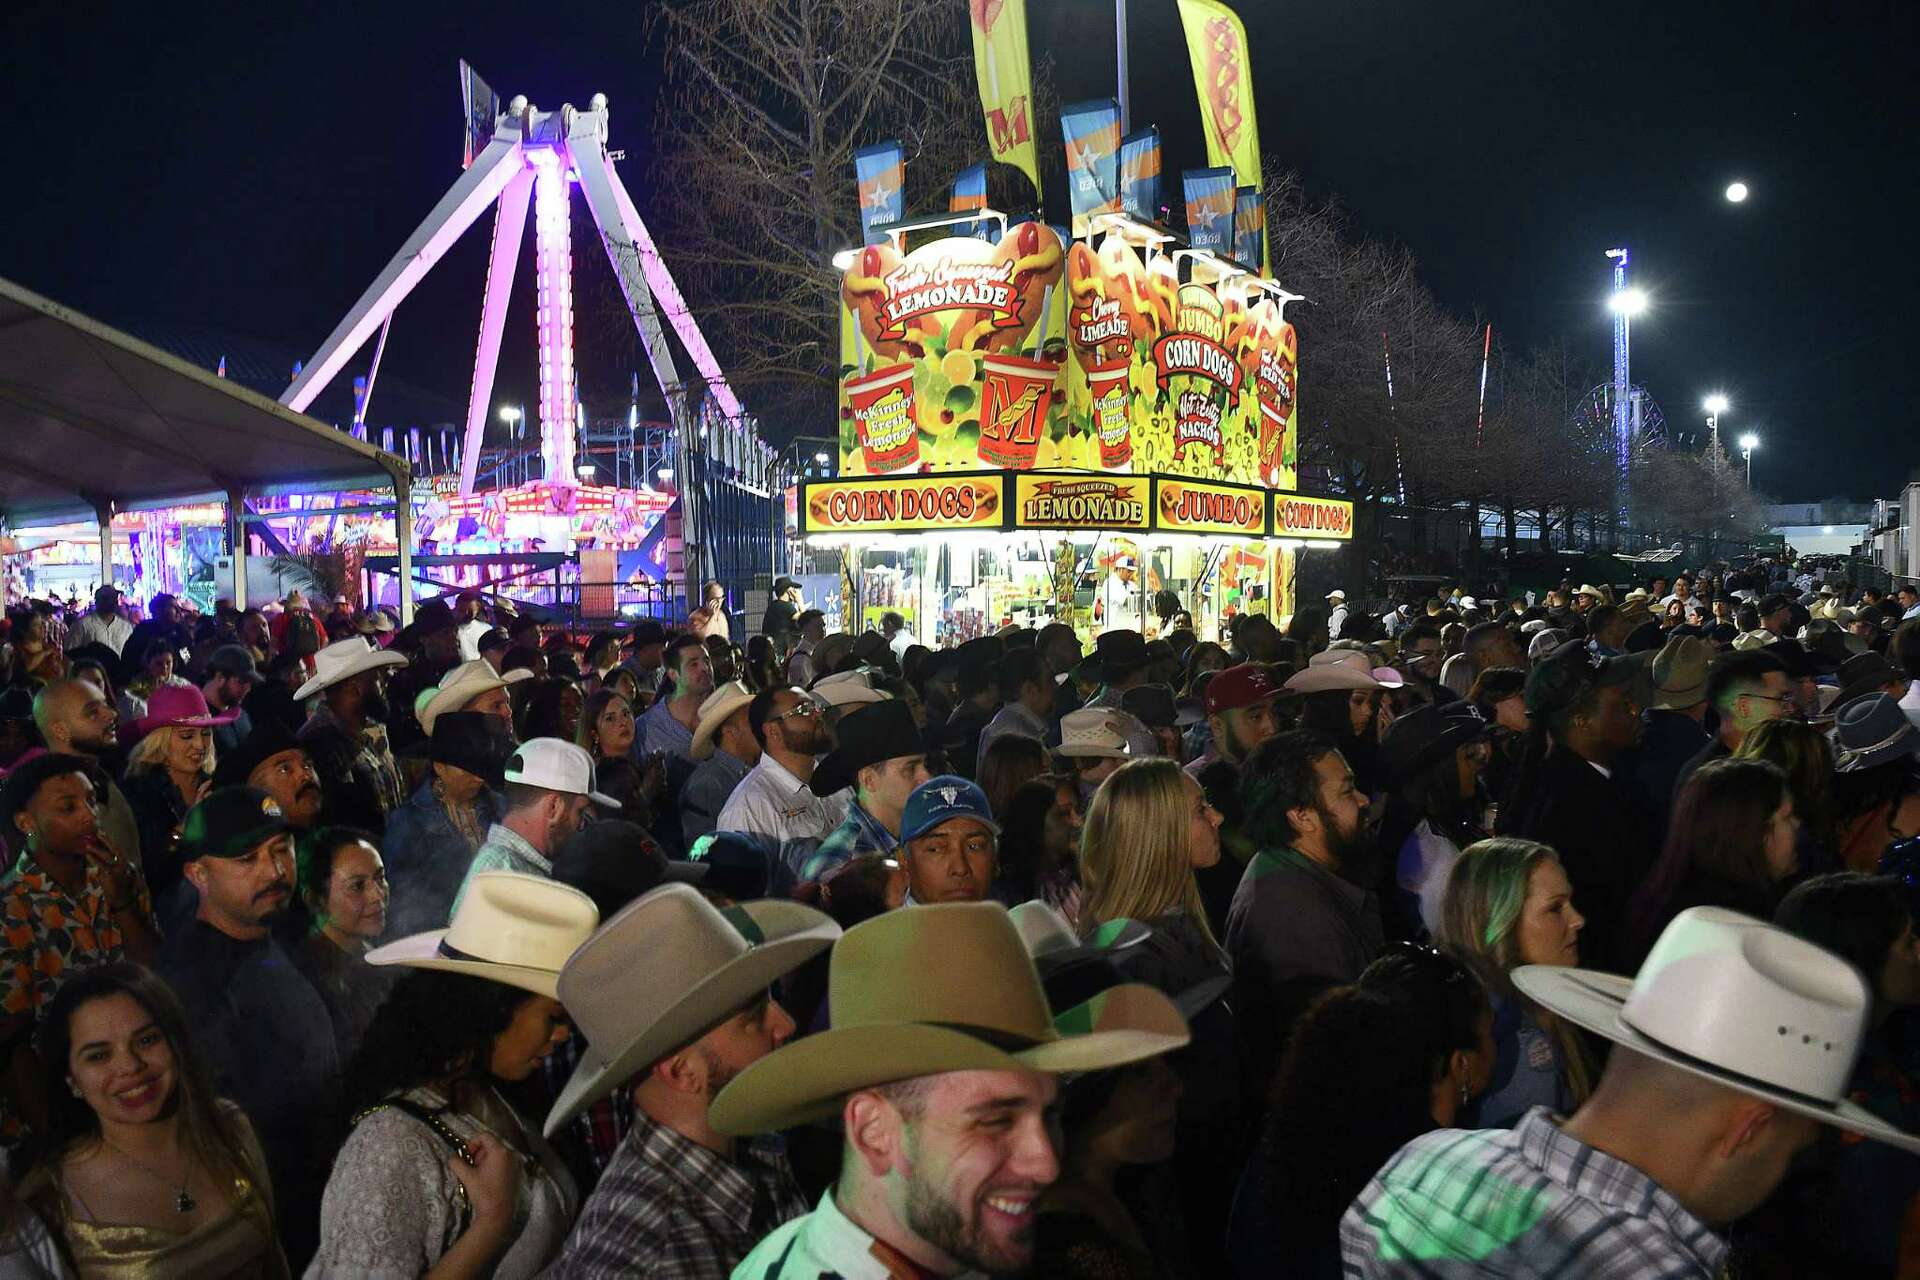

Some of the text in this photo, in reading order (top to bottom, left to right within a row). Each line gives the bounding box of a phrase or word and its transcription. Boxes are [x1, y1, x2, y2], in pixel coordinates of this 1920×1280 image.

[887, 282, 1009, 321] LEMONADE
[1081, 311, 1129, 342] LIMEADE
[1177, 308, 1223, 343] JUMBO
[1165, 338, 1201, 371] CORN
[1202, 343, 1235, 387] DOGS
[1179, 421, 1220, 446] NACHOS
[829, 486, 976, 523] CORN DOGS
[1026, 498, 1143, 522] LEMONADE
[1178, 490, 1250, 525] JUMBO
[1285, 501, 1345, 532] CORN DOGS
